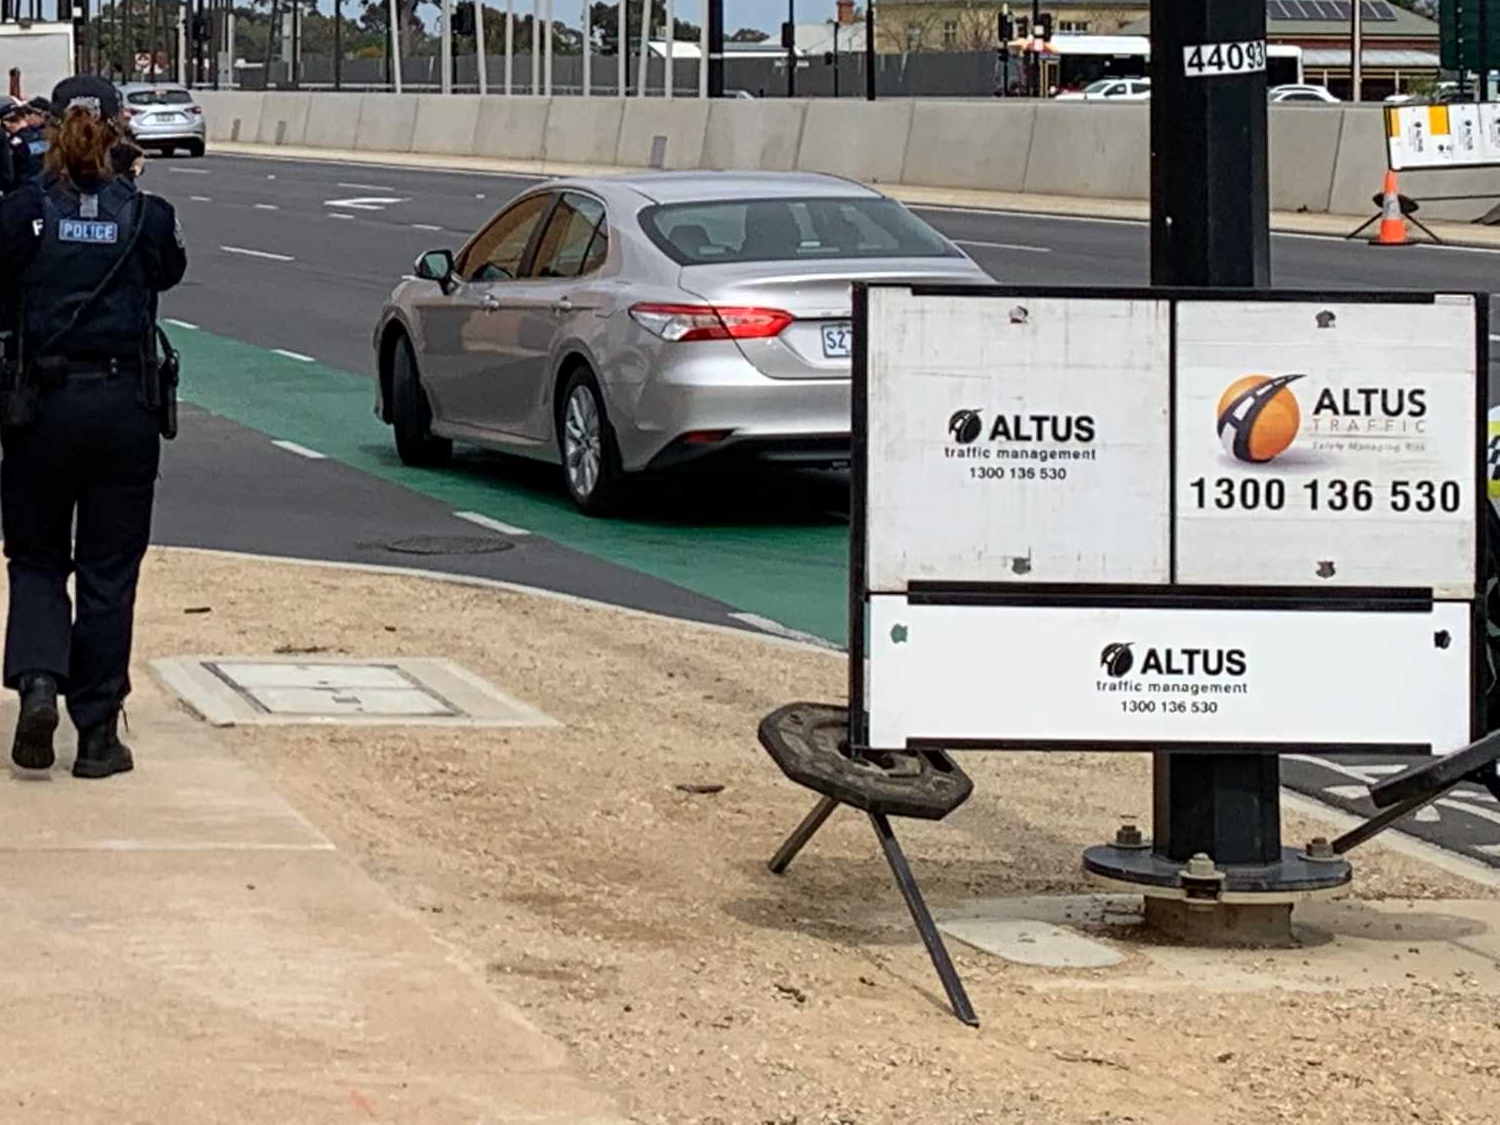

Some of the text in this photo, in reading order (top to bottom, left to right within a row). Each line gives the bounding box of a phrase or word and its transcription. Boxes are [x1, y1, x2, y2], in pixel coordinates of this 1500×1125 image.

[64, 223, 113, 239] POLICE
[1313, 388, 1426, 417] ALTUS
[989, 415, 1095, 442] ALTUS
[1313, 419, 1425, 433] TRAFFIC
[945, 447, 1096, 462] traffic management
[970, 467, 1067, 480] 1300 136 530
[1190, 477, 1460, 512] 1300 136 530
[1140, 648, 1247, 676] ALTUS
[1096, 680, 1248, 695] traffic management
[1121, 700, 1218, 713] 1300 136 530
